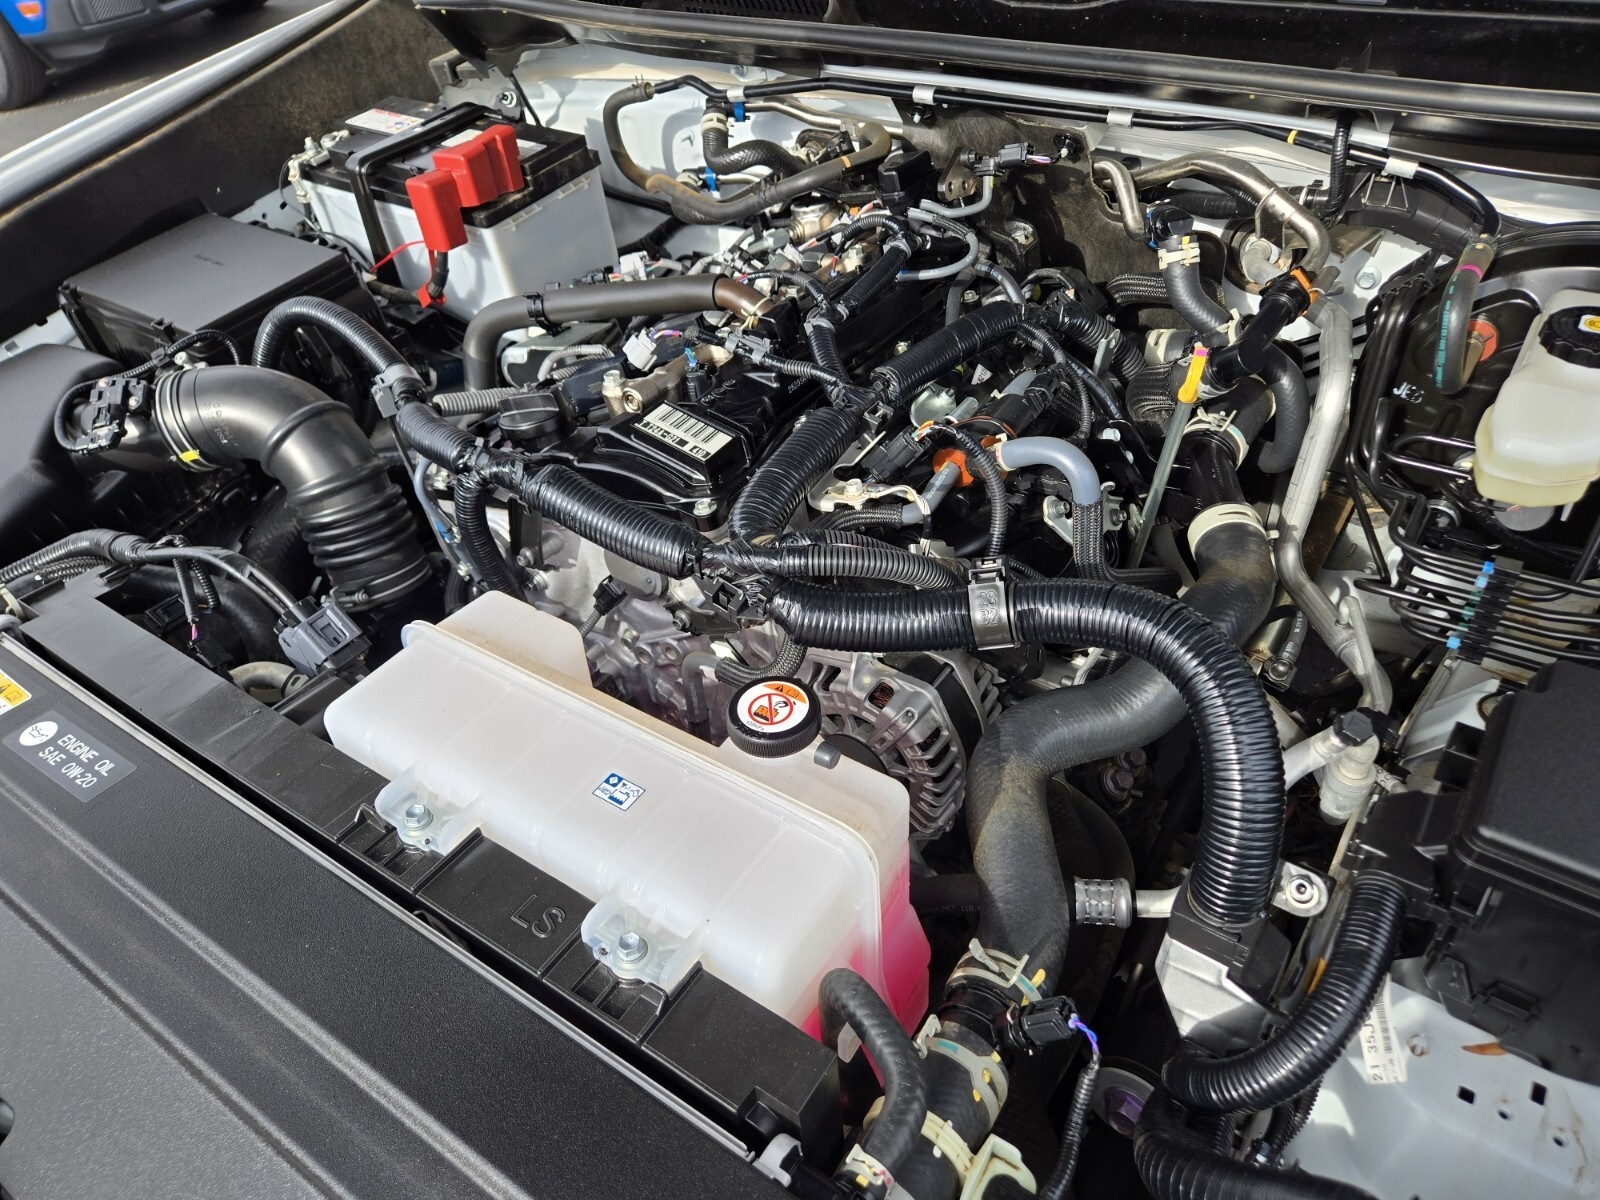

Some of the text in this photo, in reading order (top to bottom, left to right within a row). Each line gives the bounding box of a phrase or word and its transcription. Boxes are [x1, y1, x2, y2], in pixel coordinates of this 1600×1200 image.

[980, 608, 999, 626] 32
[39, 746, 97, 788] SAE 0W-20
[57, 733, 115, 777] ENGINE OIL
[510, 893, 566, 938] LS
